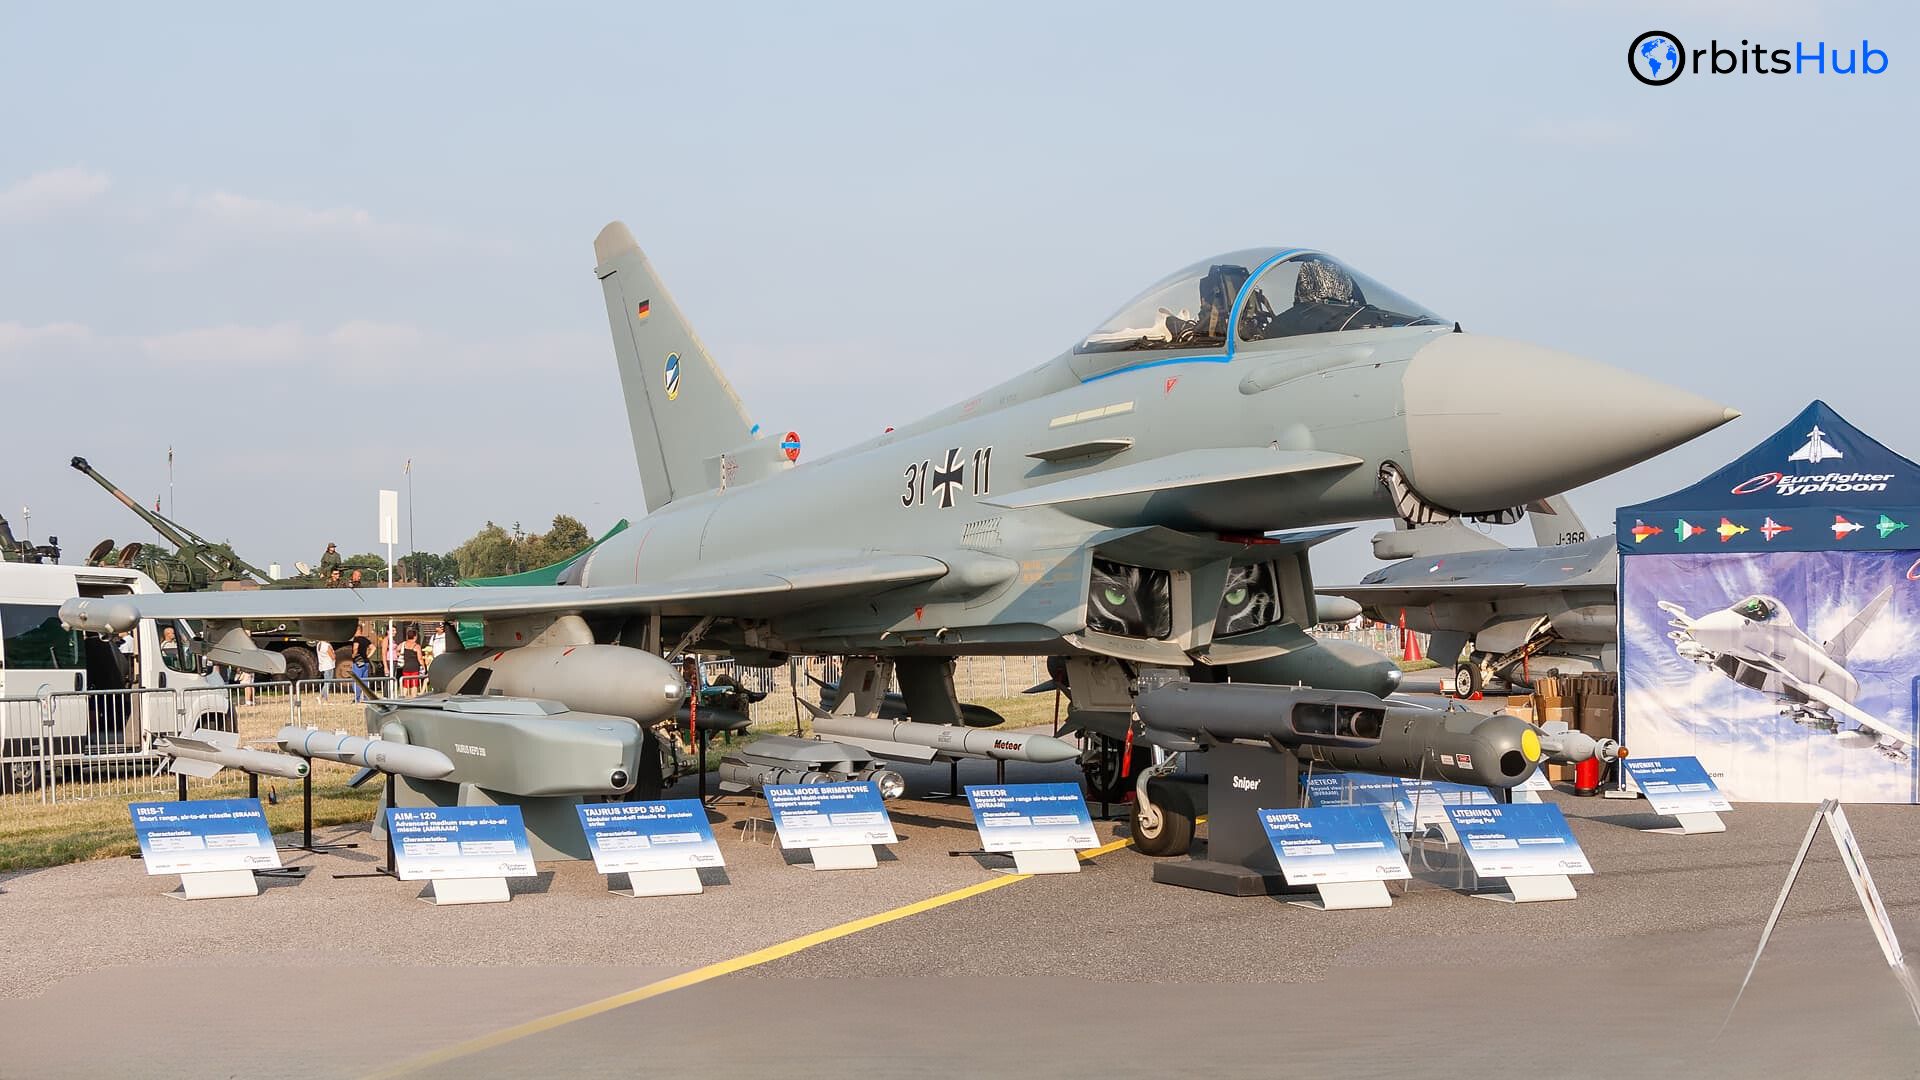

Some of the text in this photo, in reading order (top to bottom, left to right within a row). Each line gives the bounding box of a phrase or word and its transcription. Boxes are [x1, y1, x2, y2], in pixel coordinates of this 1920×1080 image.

[901, 445, 993, 508] 31 11
[1778, 472, 1895, 485] Eurofighter
[1775, 482, 1887, 496] Typhoon
[1556, 531, 1585, 545] J-368
[993, 739, 1022, 751] Meteor
[1233, 775, 1260, 791] Sniper
[770, 785, 869, 797] DUAL MODE BRIMSTONE
[972, 789, 1007, 797] METEOR
[136, 807, 164, 816] IRIS-T
[583, 805, 666, 817] TAURUS KEPD 350
[1452, 809, 1502, 818] LITENING III
[1266, 814, 1301, 823] SNIPER
[1455, 817, 1483, 825] Targeting
[422, 825, 459, 833] (AMRAAM)
[1269, 822, 1299, 831] Targeting
